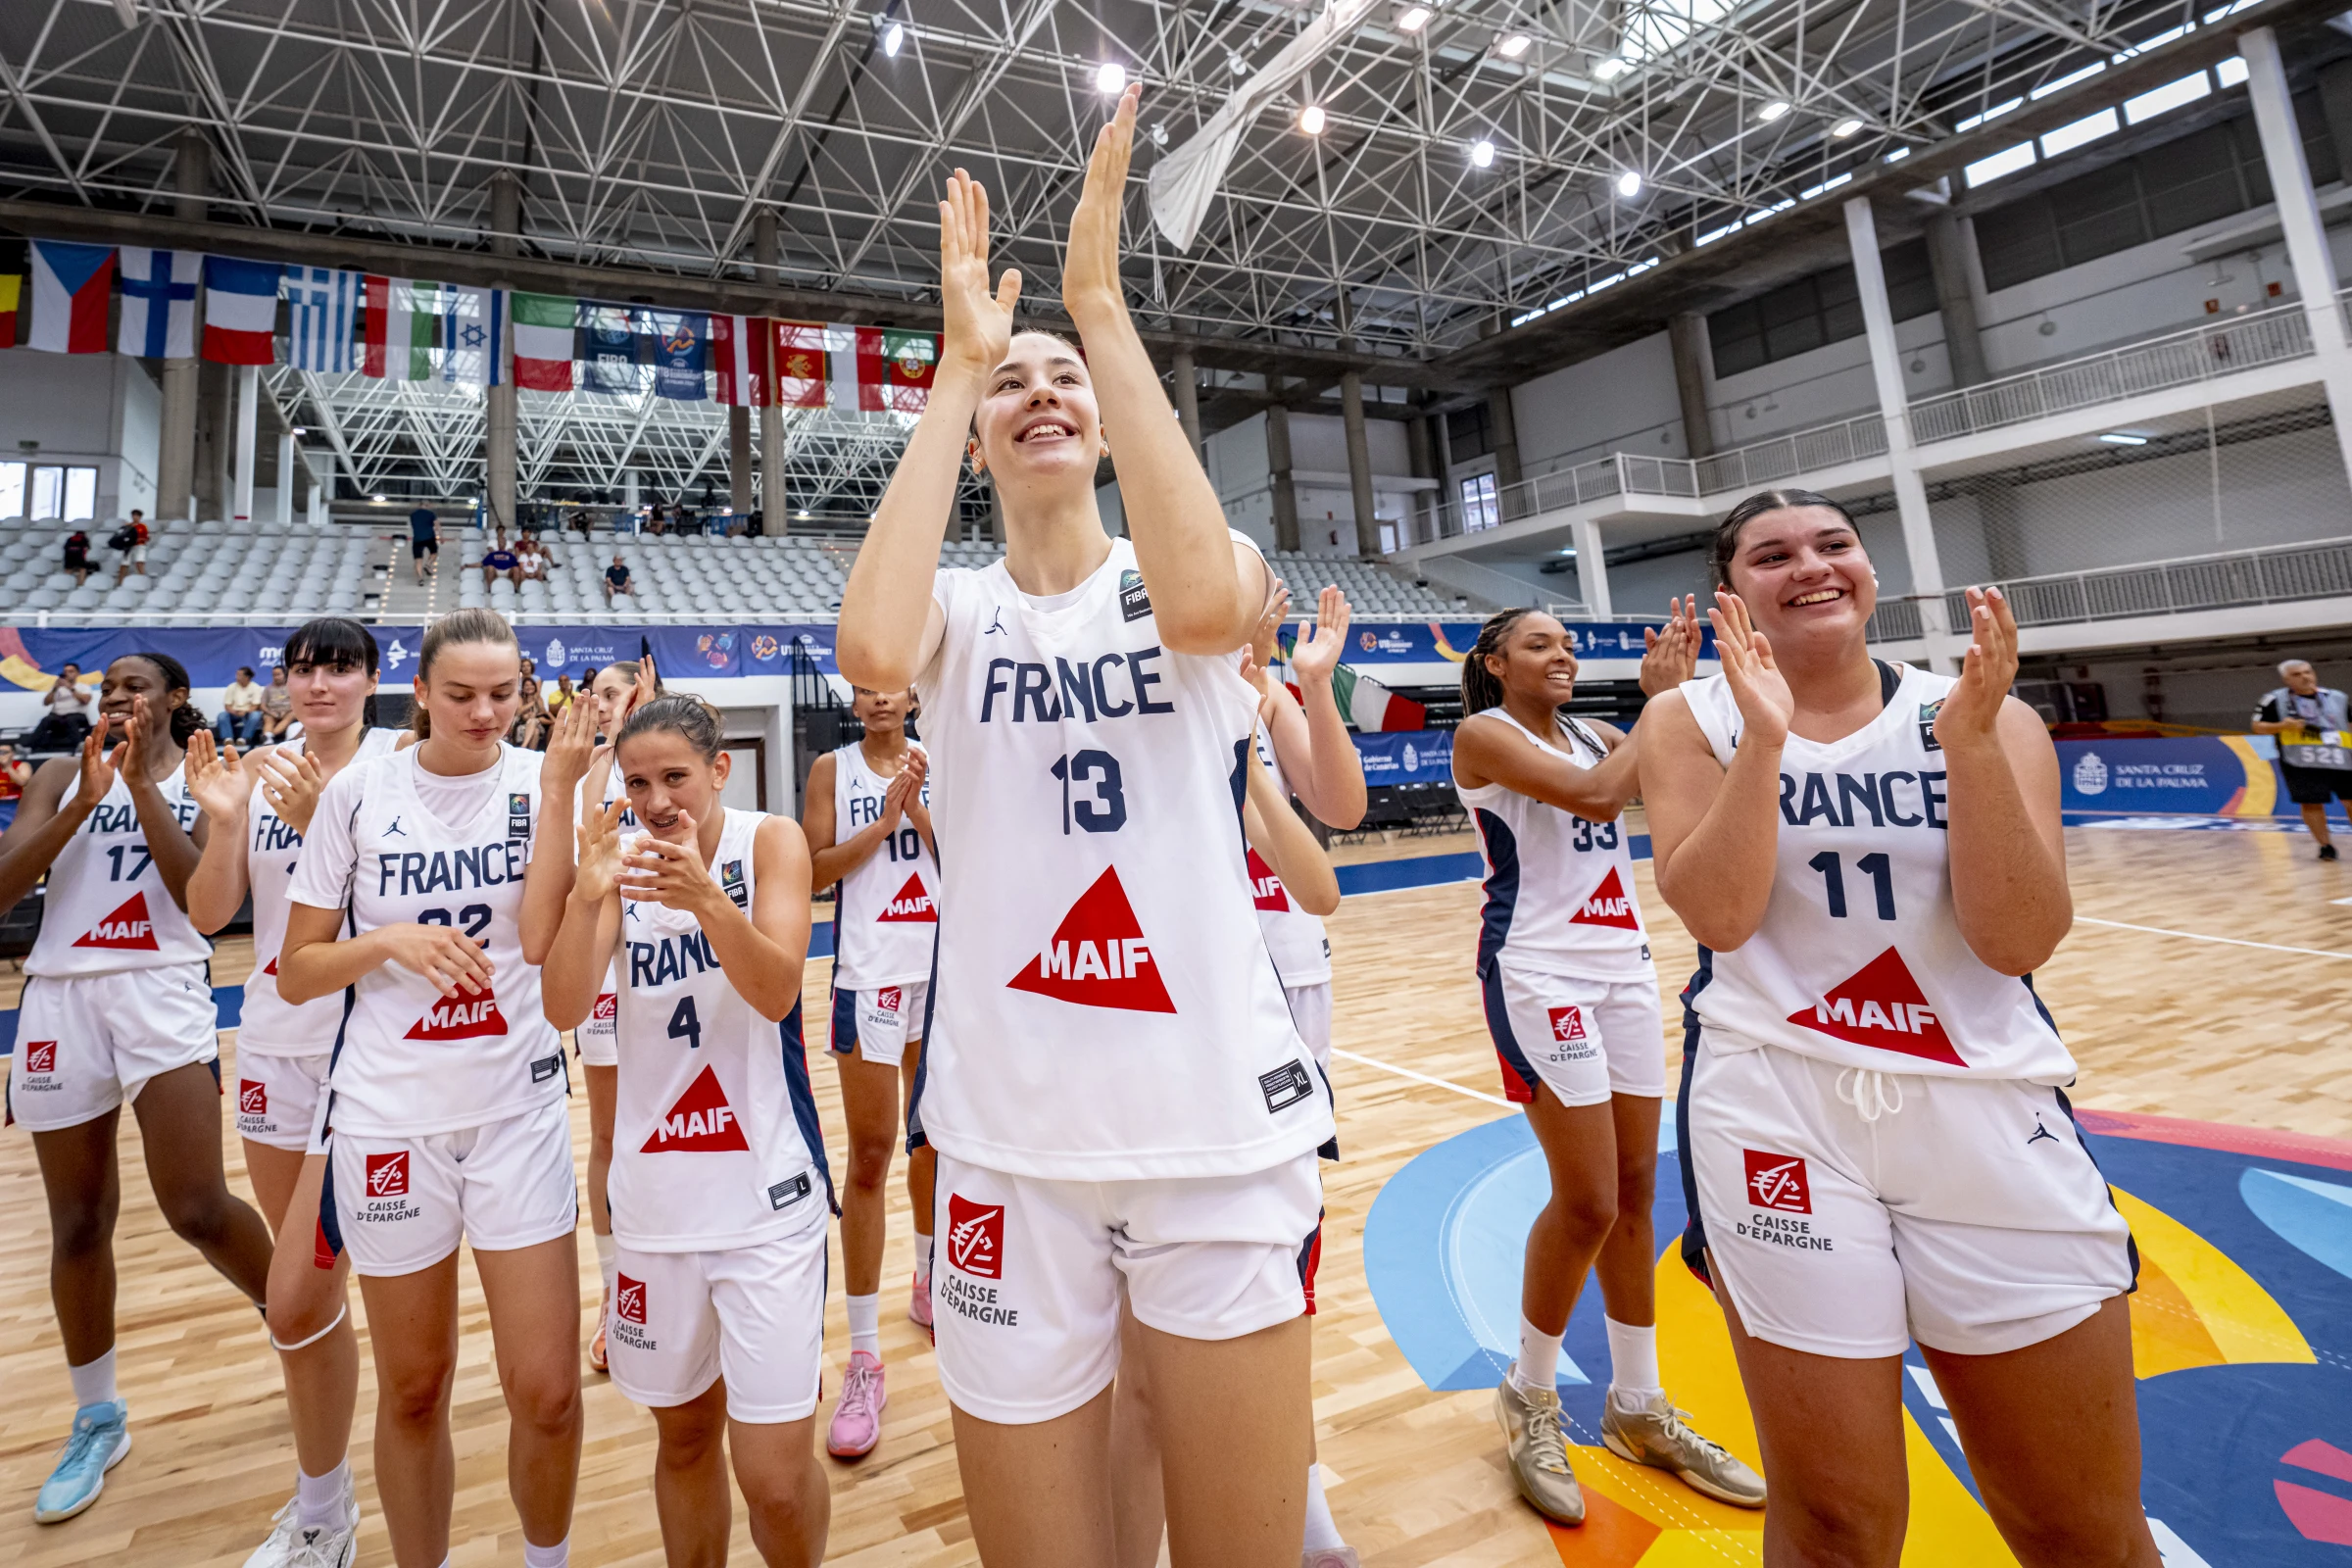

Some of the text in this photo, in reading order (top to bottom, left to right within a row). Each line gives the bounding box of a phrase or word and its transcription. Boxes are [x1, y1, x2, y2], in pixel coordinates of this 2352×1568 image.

[1125, 588, 1149, 605] FIBA
[2116, 764, 2204, 775] SANTA CRUZ
[1050, 750, 1127, 835] 13
[2116, 777, 2209, 788] DE LA PALMA
[1779, 770, 1948, 829] RANCE
[511, 818, 527, 827] FIBA
[1572, 814, 1618, 853] 33
[885, 828, 920, 862] 10
[107, 845, 152, 881] 17
[378, 839, 525, 897] FRANCE
[727, 886, 744, 899] FIBA
[1250, 876, 1280, 899] AIF
[1808, 851, 1896, 920] 11
[886, 897, 930, 917] MAIF
[1584, 897, 1629, 918] MAIF
[89, 922, 152, 942] MAIF
[625, 929, 721, 988] RANC
[1040, 937, 1149, 980] MAIF
[421, 999, 496, 1033] MAIF
[667, 995, 701, 1049] 4
[876, 1009, 895, 1019] CAISSE
[1816, 997, 1936, 1035] MAIF
[1550, 1049, 1598, 1061] D'EPARGNE
[1558, 1041, 1590, 1054] CAISSE
[1294, 1071, 1308, 1088] XL
[240, 1115, 266, 1124] CAISSE
[658, 1106, 733, 1143] MAIF
[800, 1181, 807, 1191] L
[357, 1206, 420, 1223] D'EPARGNE
[368, 1199, 407, 1212] CAISSE
[1752, 1213, 1810, 1234] CAISSE
[949, 1274, 998, 1304] CAISSE
[941, 1281, 1018, 1326] D'EPARGNE
[616, 1320, 645, 1339] CAISSE
